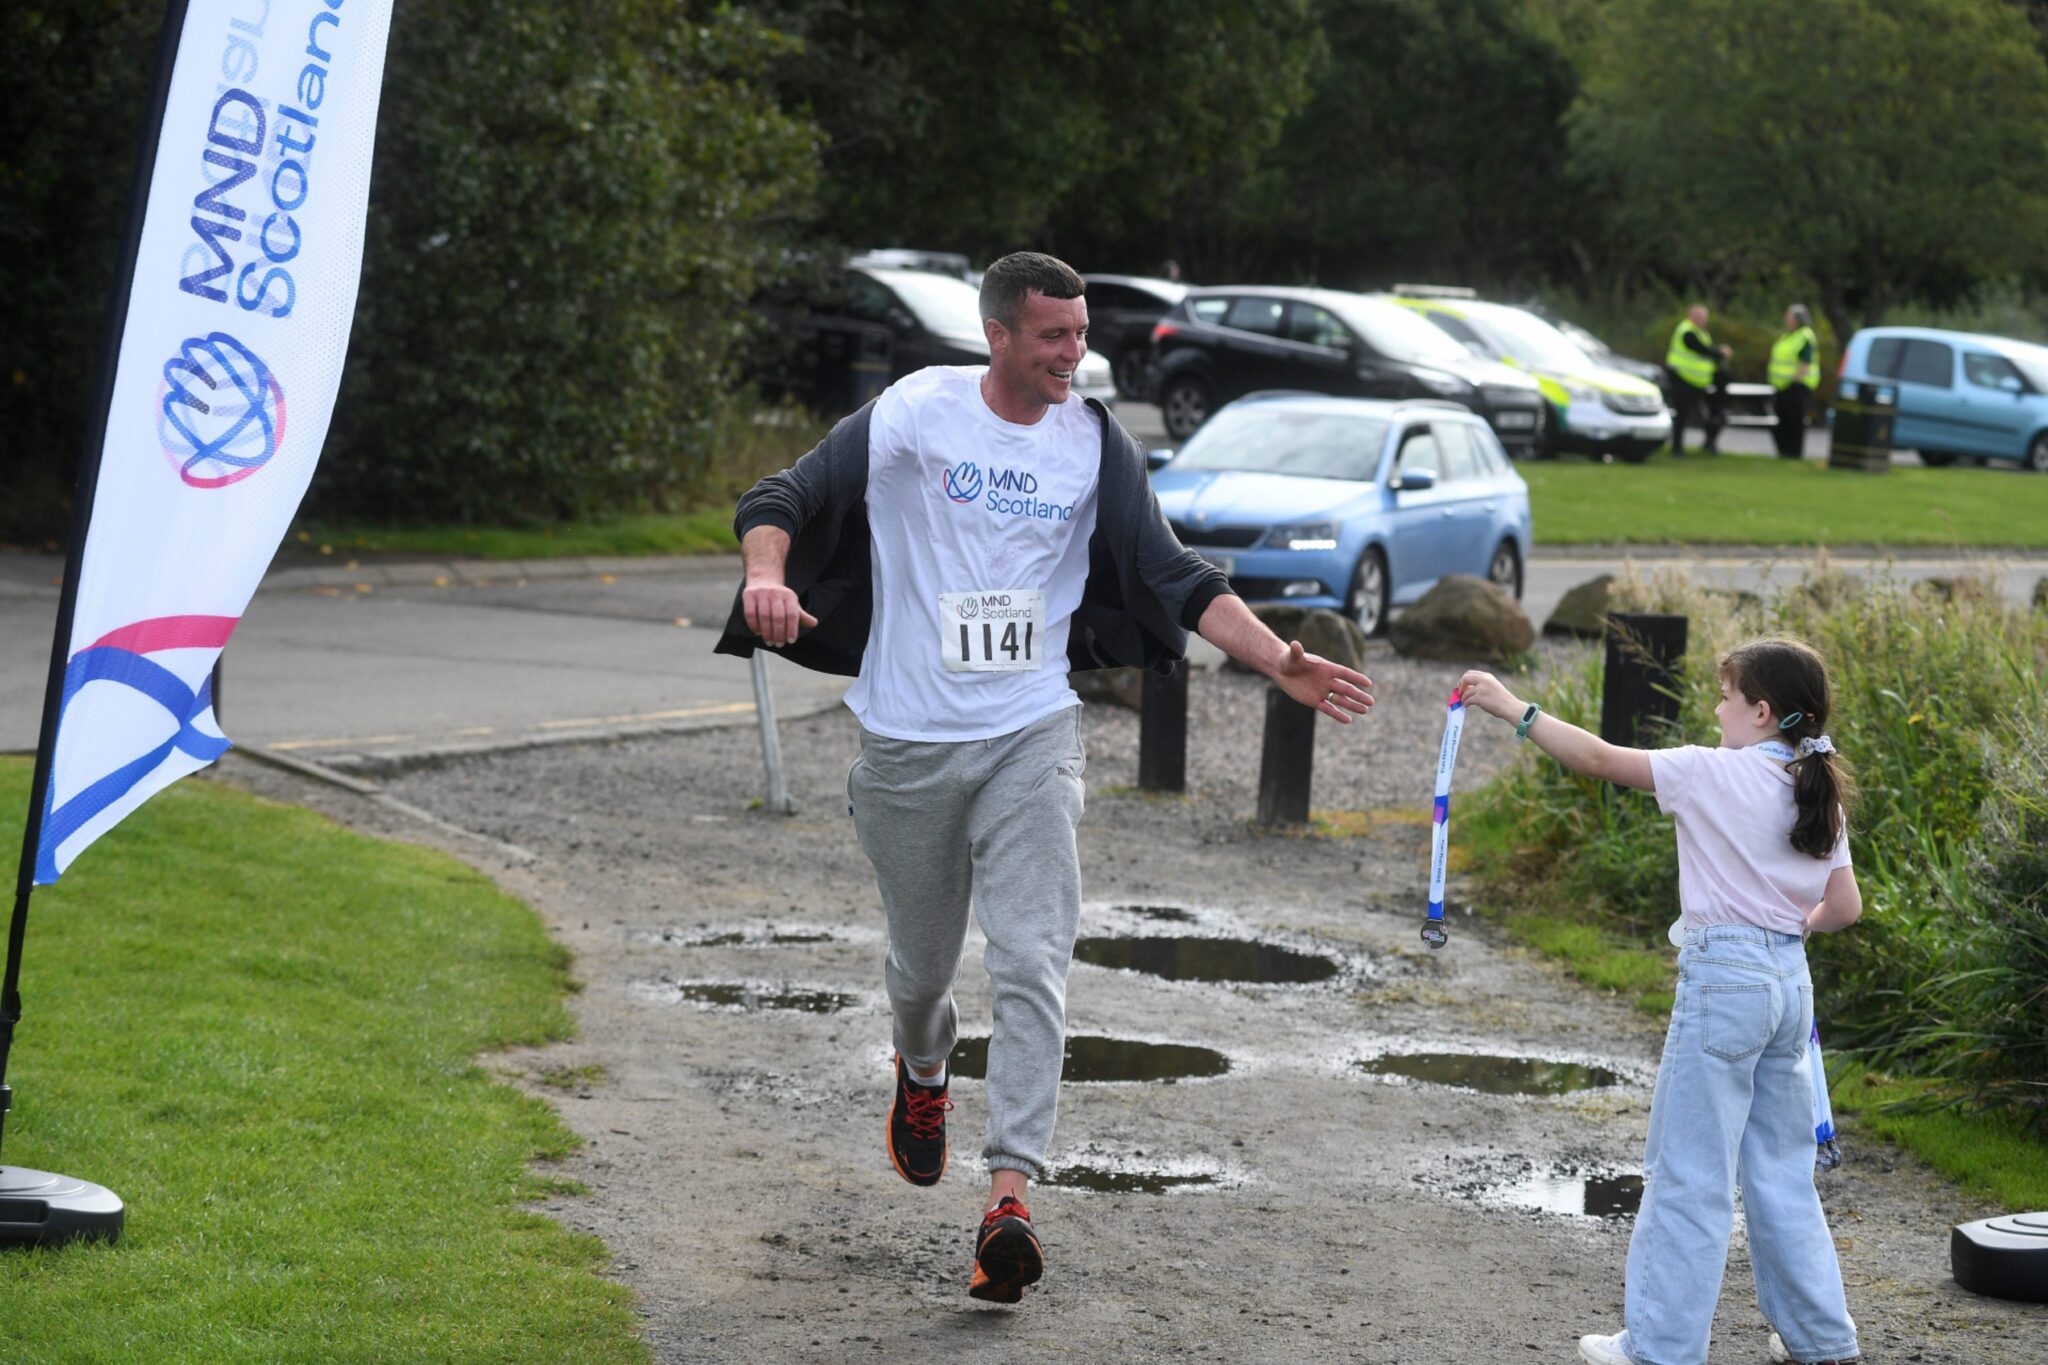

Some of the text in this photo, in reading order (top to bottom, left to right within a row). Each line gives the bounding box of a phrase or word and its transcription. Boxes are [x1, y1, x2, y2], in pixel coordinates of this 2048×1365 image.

[237, 0, 344, 318] Scotlan
[179, 88, 267, 303] MND
[988, 467, 1038, 494] MND
[986, 490, 1076, 521] Scotland
[981, 594, 1012, 607] MND
[982, 607, 1033, 620] Scotland
[959, 622, 1033, 662] 1141
